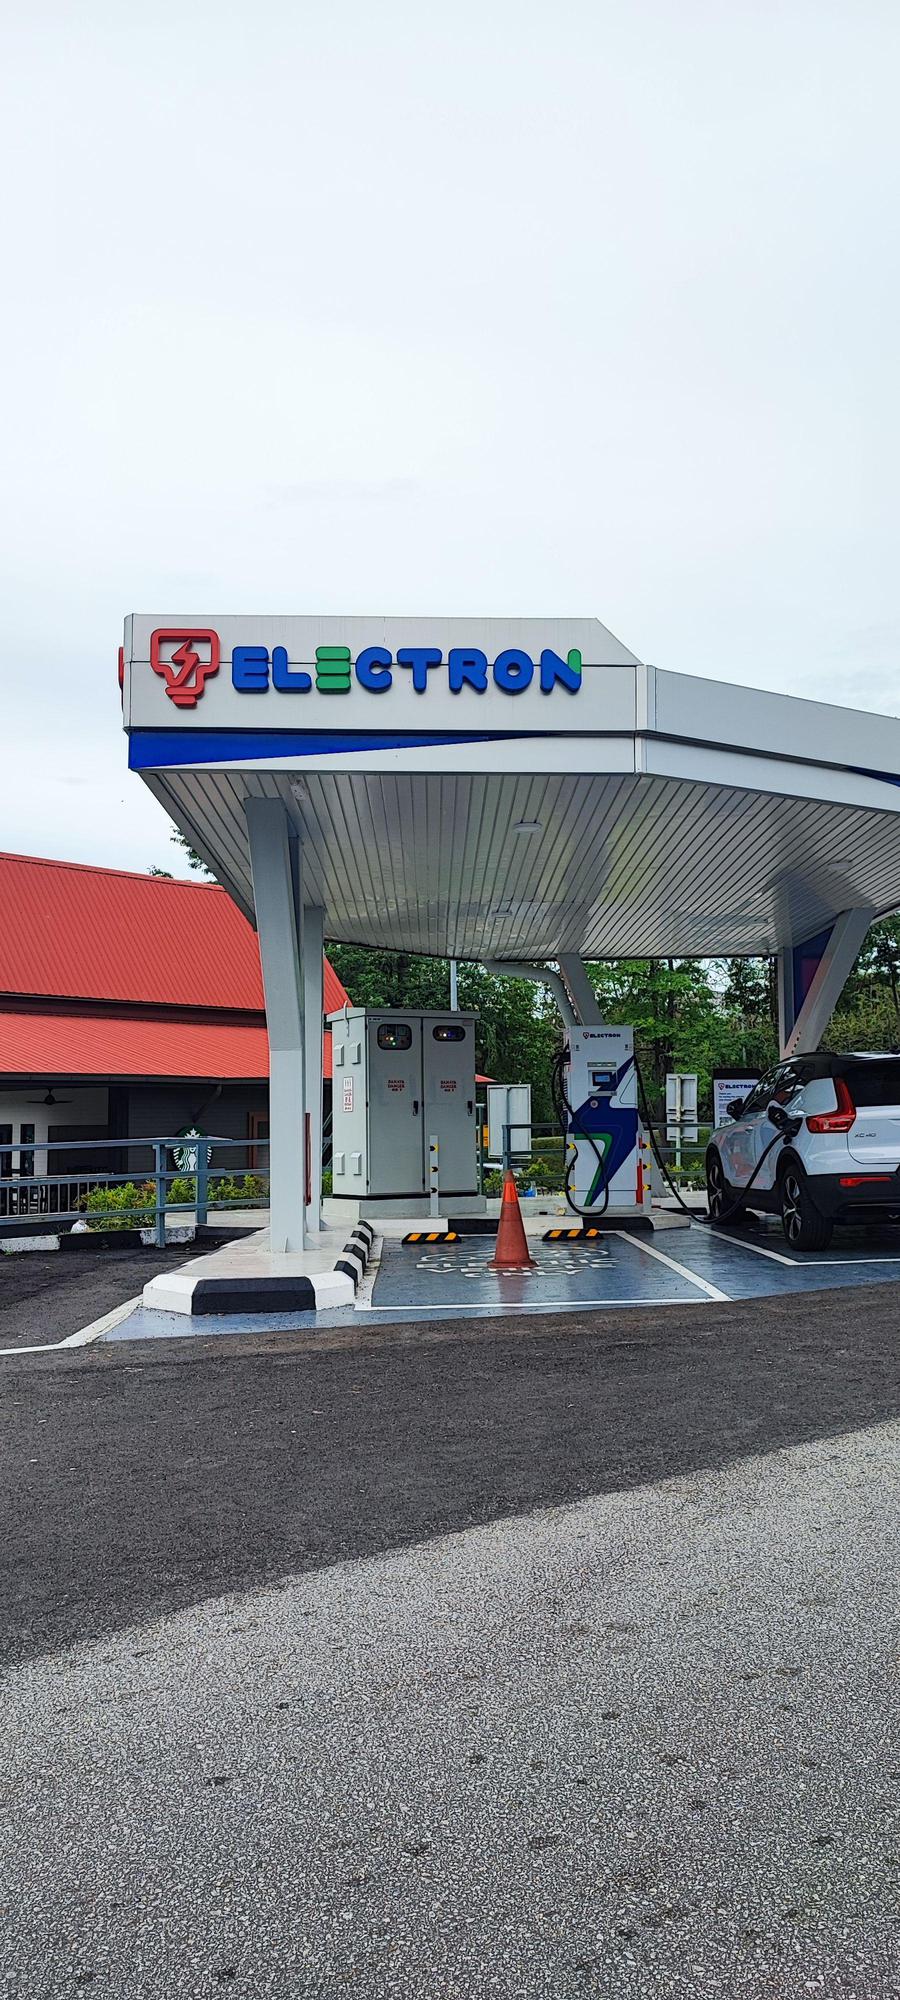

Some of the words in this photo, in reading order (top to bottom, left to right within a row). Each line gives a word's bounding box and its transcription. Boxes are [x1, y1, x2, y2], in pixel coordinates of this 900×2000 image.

[231, 646, 583, 695] ELECTRON
[416, 1258, 620, 1269] ELERIC
[464, 1269, 583, 1278] ONLY
